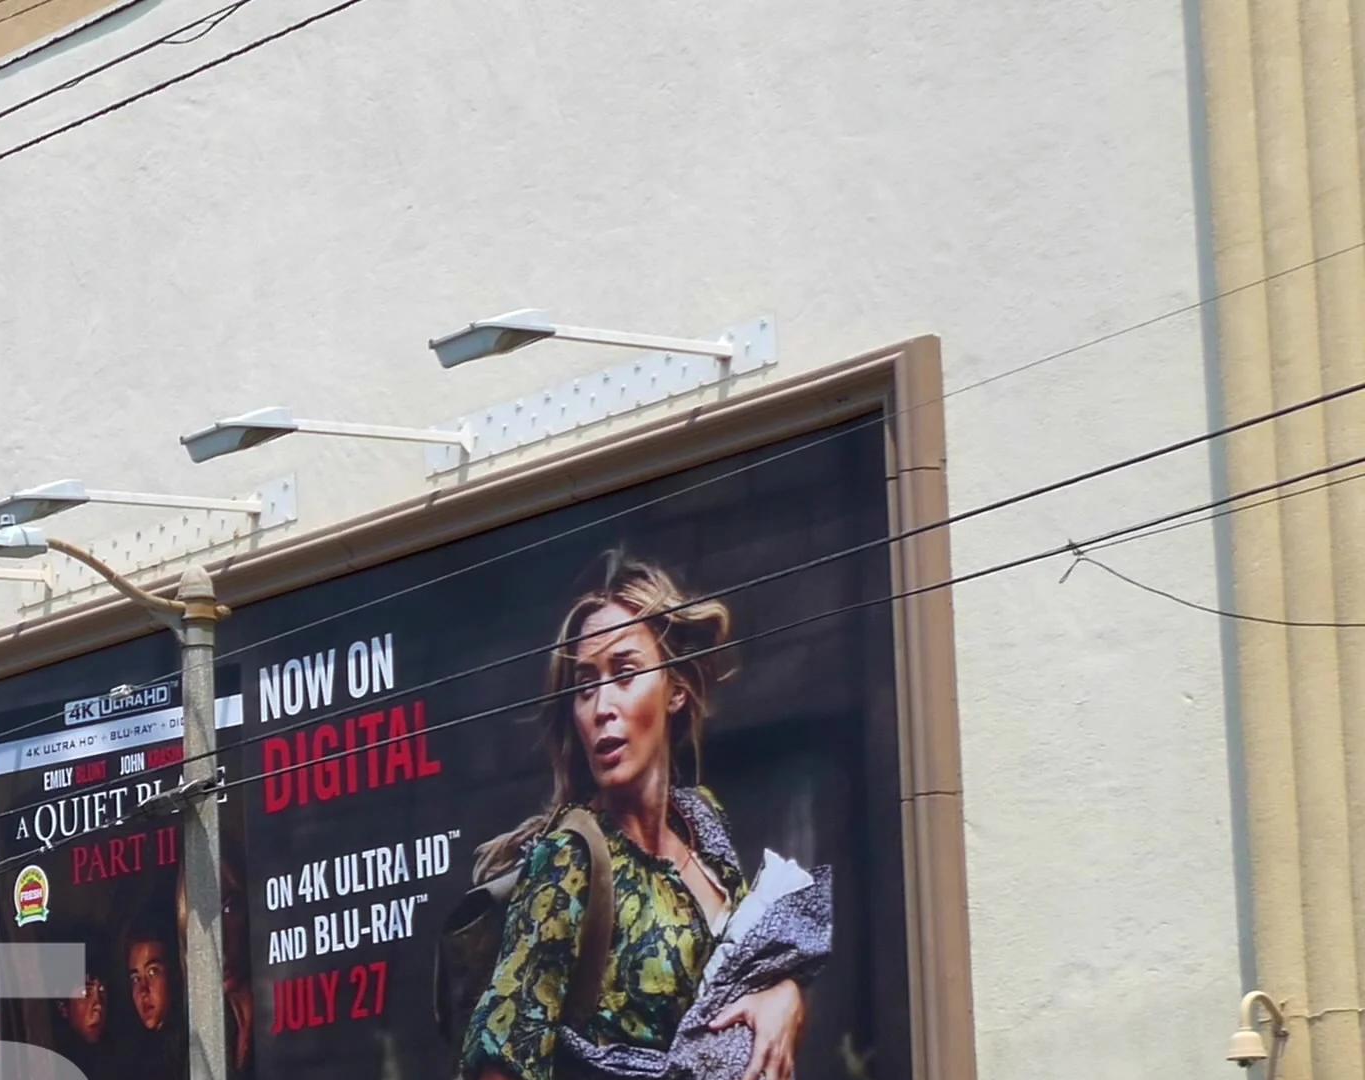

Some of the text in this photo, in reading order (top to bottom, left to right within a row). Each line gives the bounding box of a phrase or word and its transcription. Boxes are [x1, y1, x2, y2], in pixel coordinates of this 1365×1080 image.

[259, 633, 395, 723] NOW ON
[69, 702, 95, 720] 4K
[26, 747, 40, 758] 4K
[43, 739, 76, 755] ULTRA
[43, 767, 74, 791] EMILY
[75, 760, 108, 785] BLUNT
[119, 752, 145, 776] JOHN
[262, 699, 442, 815] DIGITAL
[16, 815, 30, 840] A
[34, 786, 129, 850] QUIET
[72, 826, 178, 885] PART II
[266, 874, 294, 911] ON
[298, 860, 330, 903] 4K
[334, 843, 410, 897] ULTRA
[269, 926, 308, 965] AND
[272, 961, 388, 1036] JULY 27
